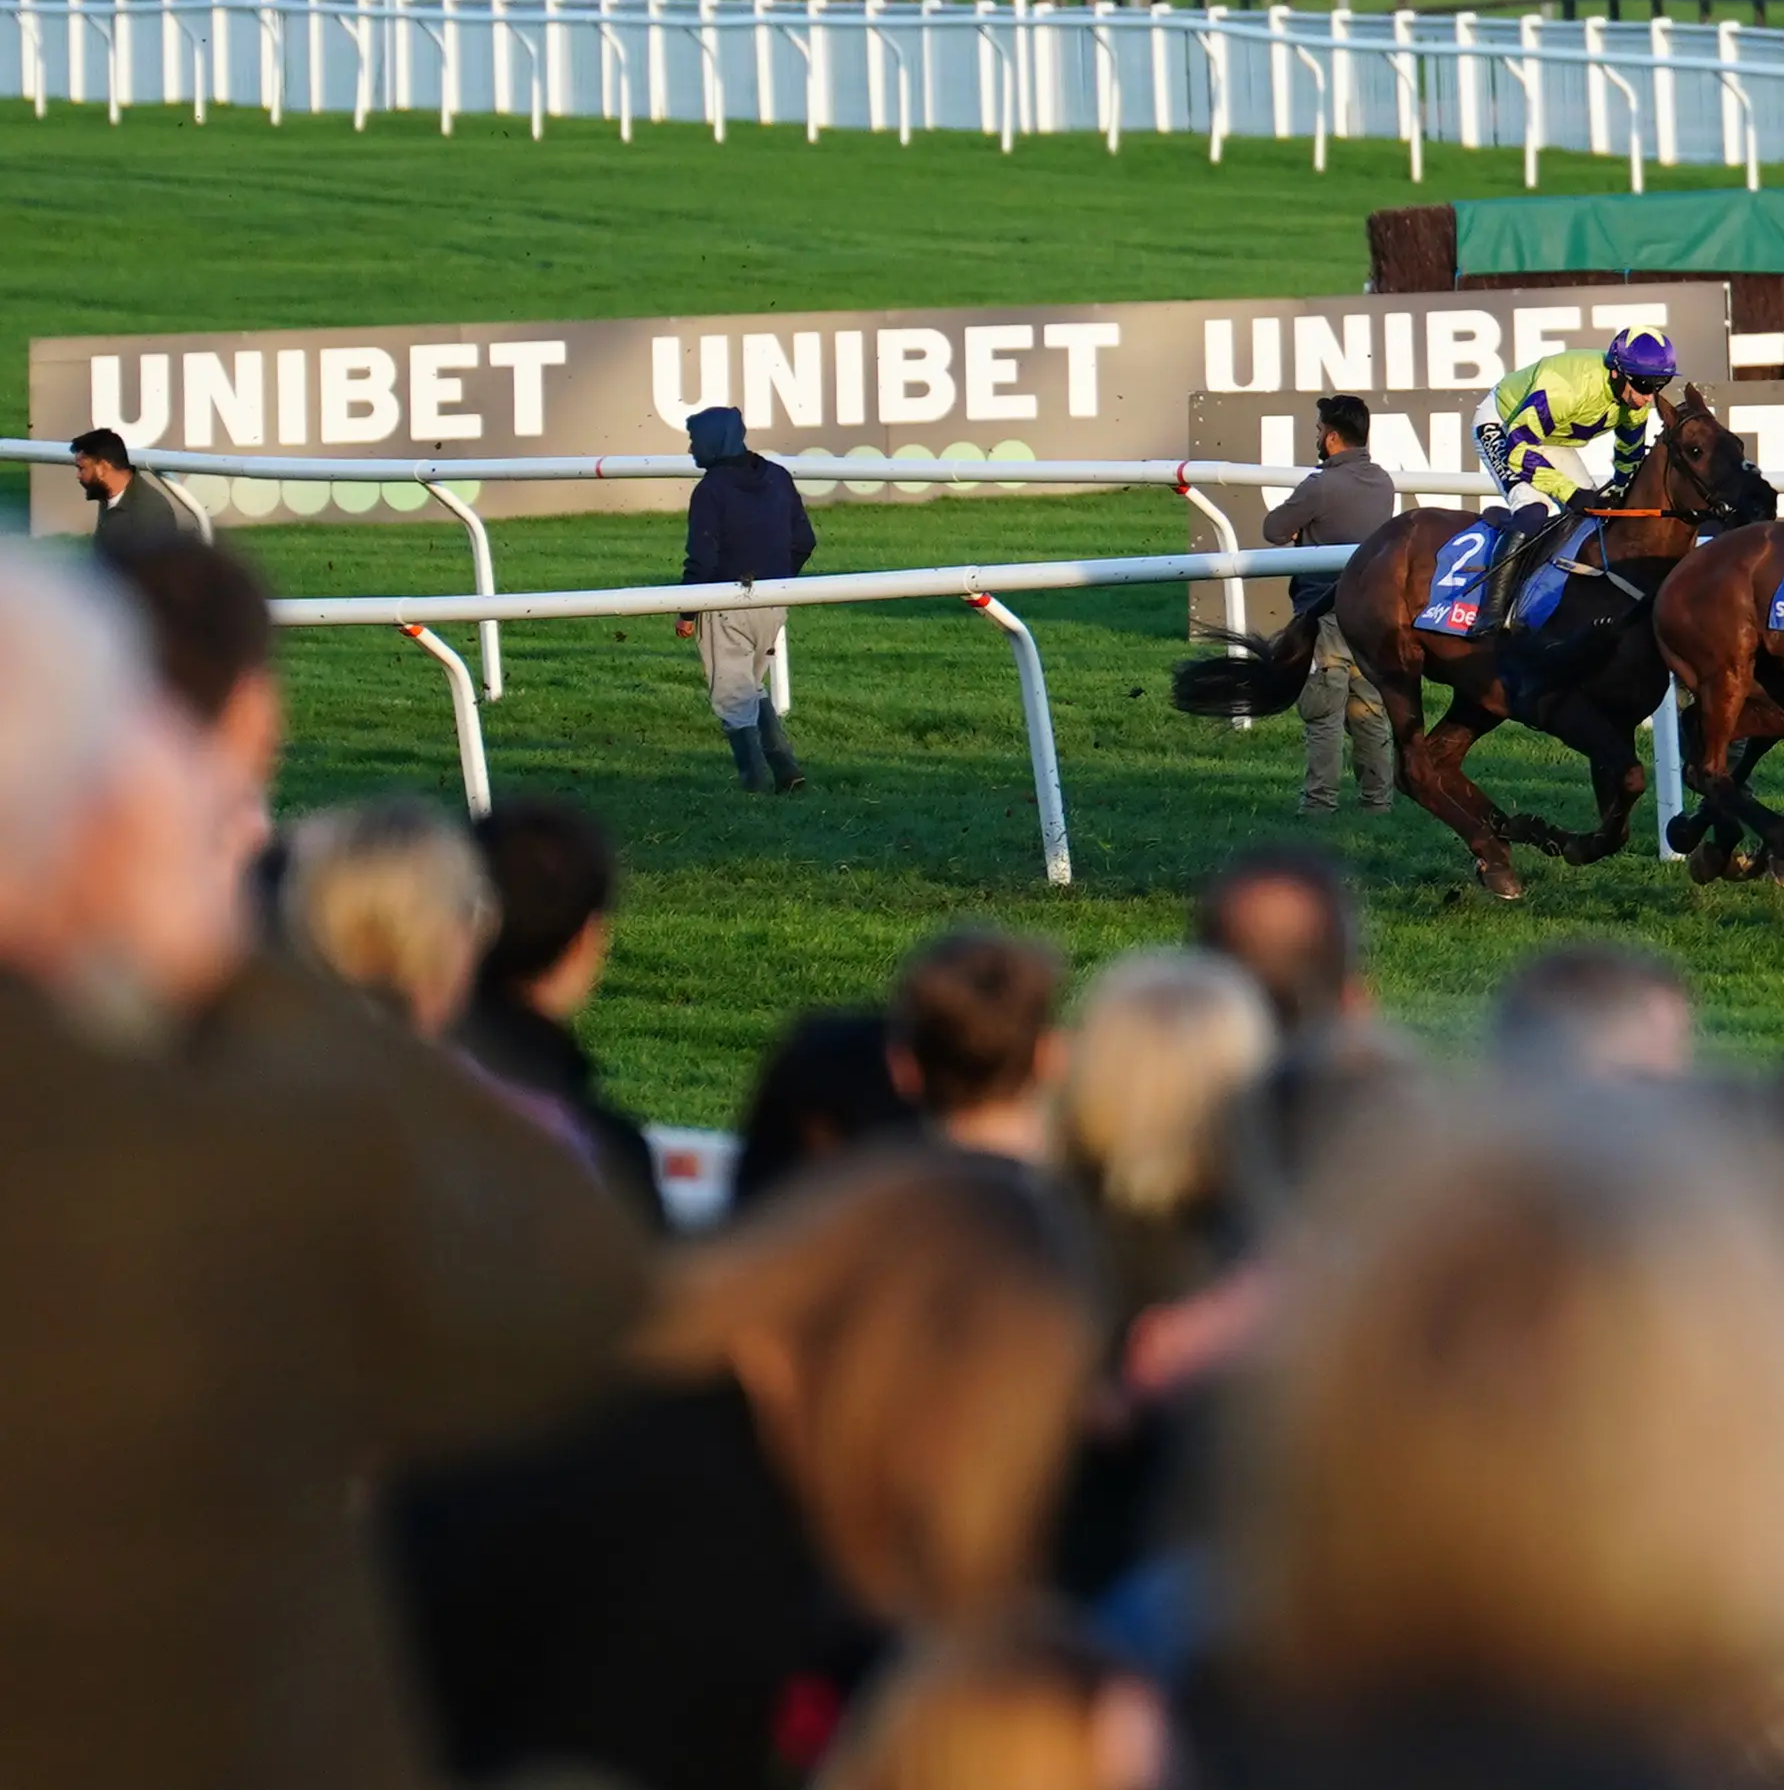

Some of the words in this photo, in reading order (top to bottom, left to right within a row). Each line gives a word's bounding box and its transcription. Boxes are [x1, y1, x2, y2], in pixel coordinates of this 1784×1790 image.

[90, 340, 566, 449] UNIBET
[652, 323, 1119, 433] UNIBET
[1437, 532, 1486, 587] 2
[1421, 602, 1452, 624] sky
[1450, 603, 1477, 626] be
